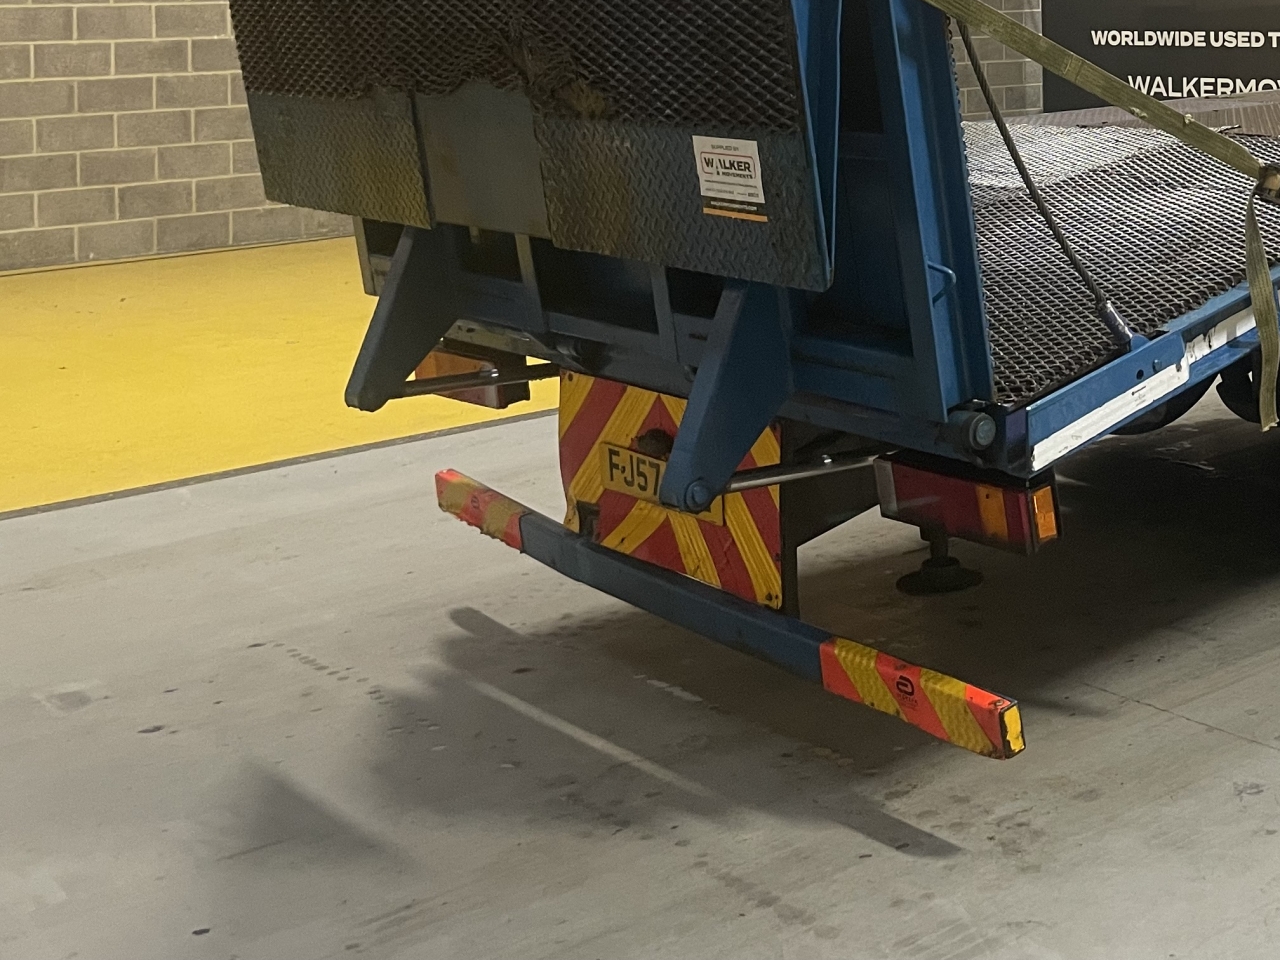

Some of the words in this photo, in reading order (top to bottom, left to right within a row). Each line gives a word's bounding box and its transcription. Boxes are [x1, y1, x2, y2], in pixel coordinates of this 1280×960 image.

[1091, 30, 1206, 47] WORLDWIDE
[1209, 31, 1265, 48] USED
[703, 156, 752, 176] WALKER
